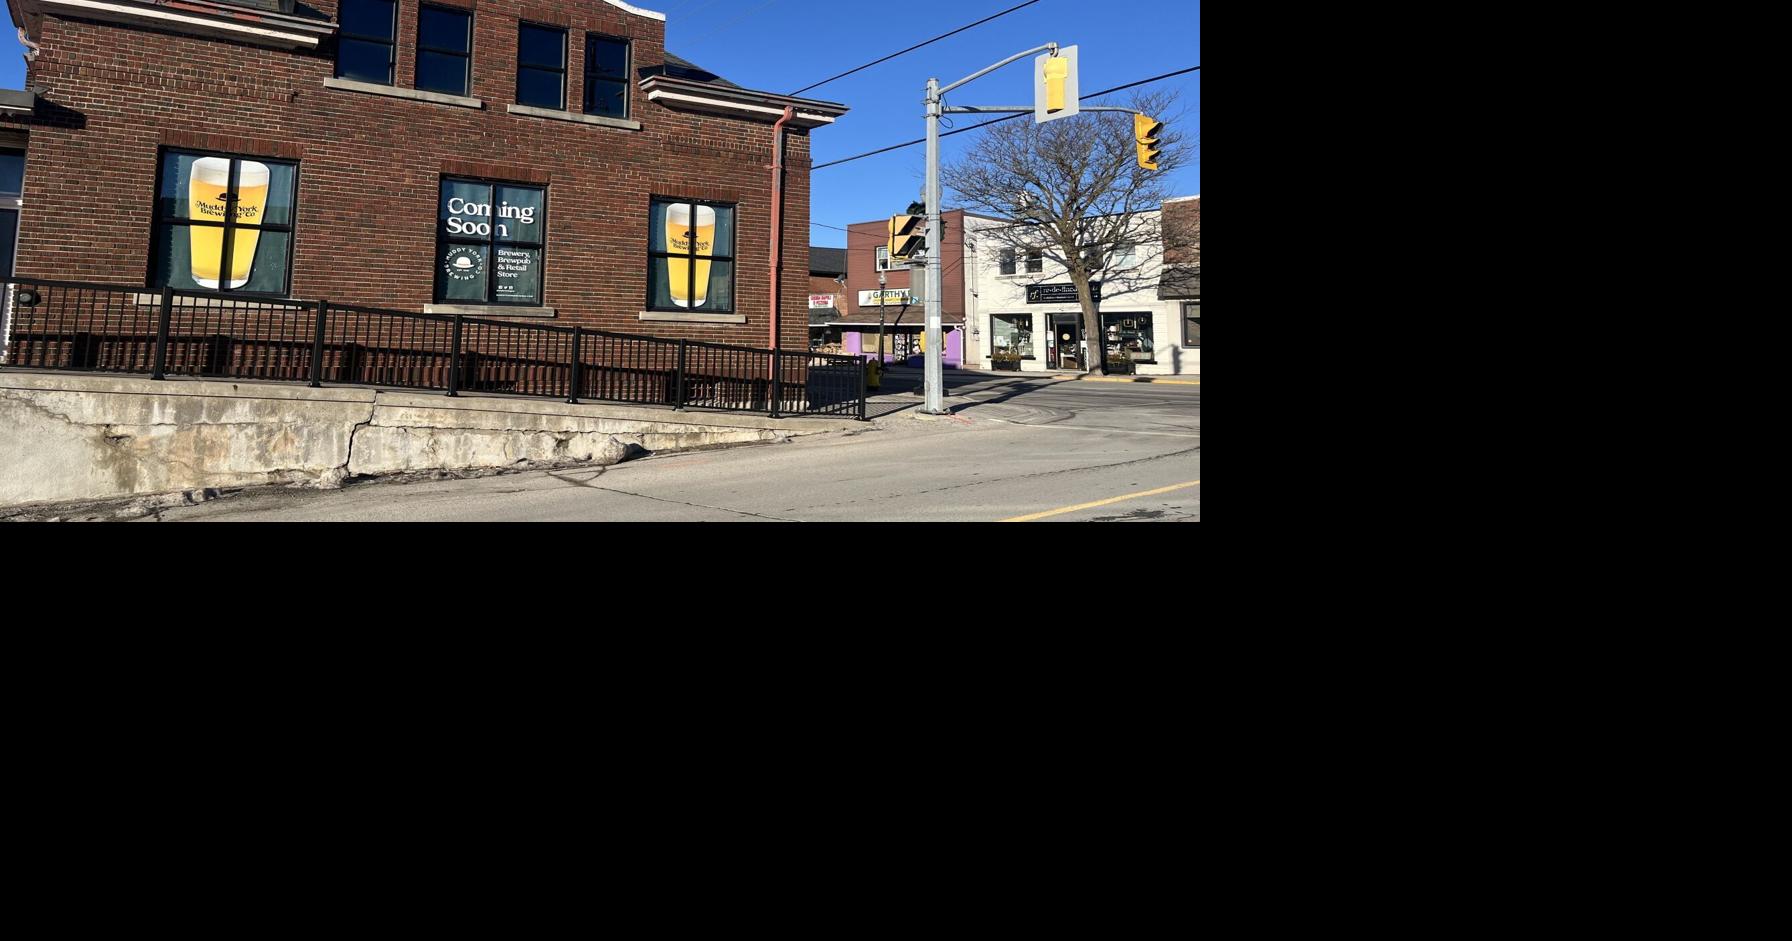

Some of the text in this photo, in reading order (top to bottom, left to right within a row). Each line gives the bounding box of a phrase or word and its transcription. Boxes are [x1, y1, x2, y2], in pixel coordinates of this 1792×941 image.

[195, 200, 226, 211] Mudd
[447, 197, 535, 224] Coming
[446, 216, 508, 237] Soon
[446, 247, 466, 261] MUDDY
[497, 256, 531, 264] Brewpub
[497, 270, 518, 278] Store
[872, 290, 906, 298] GRTHY
